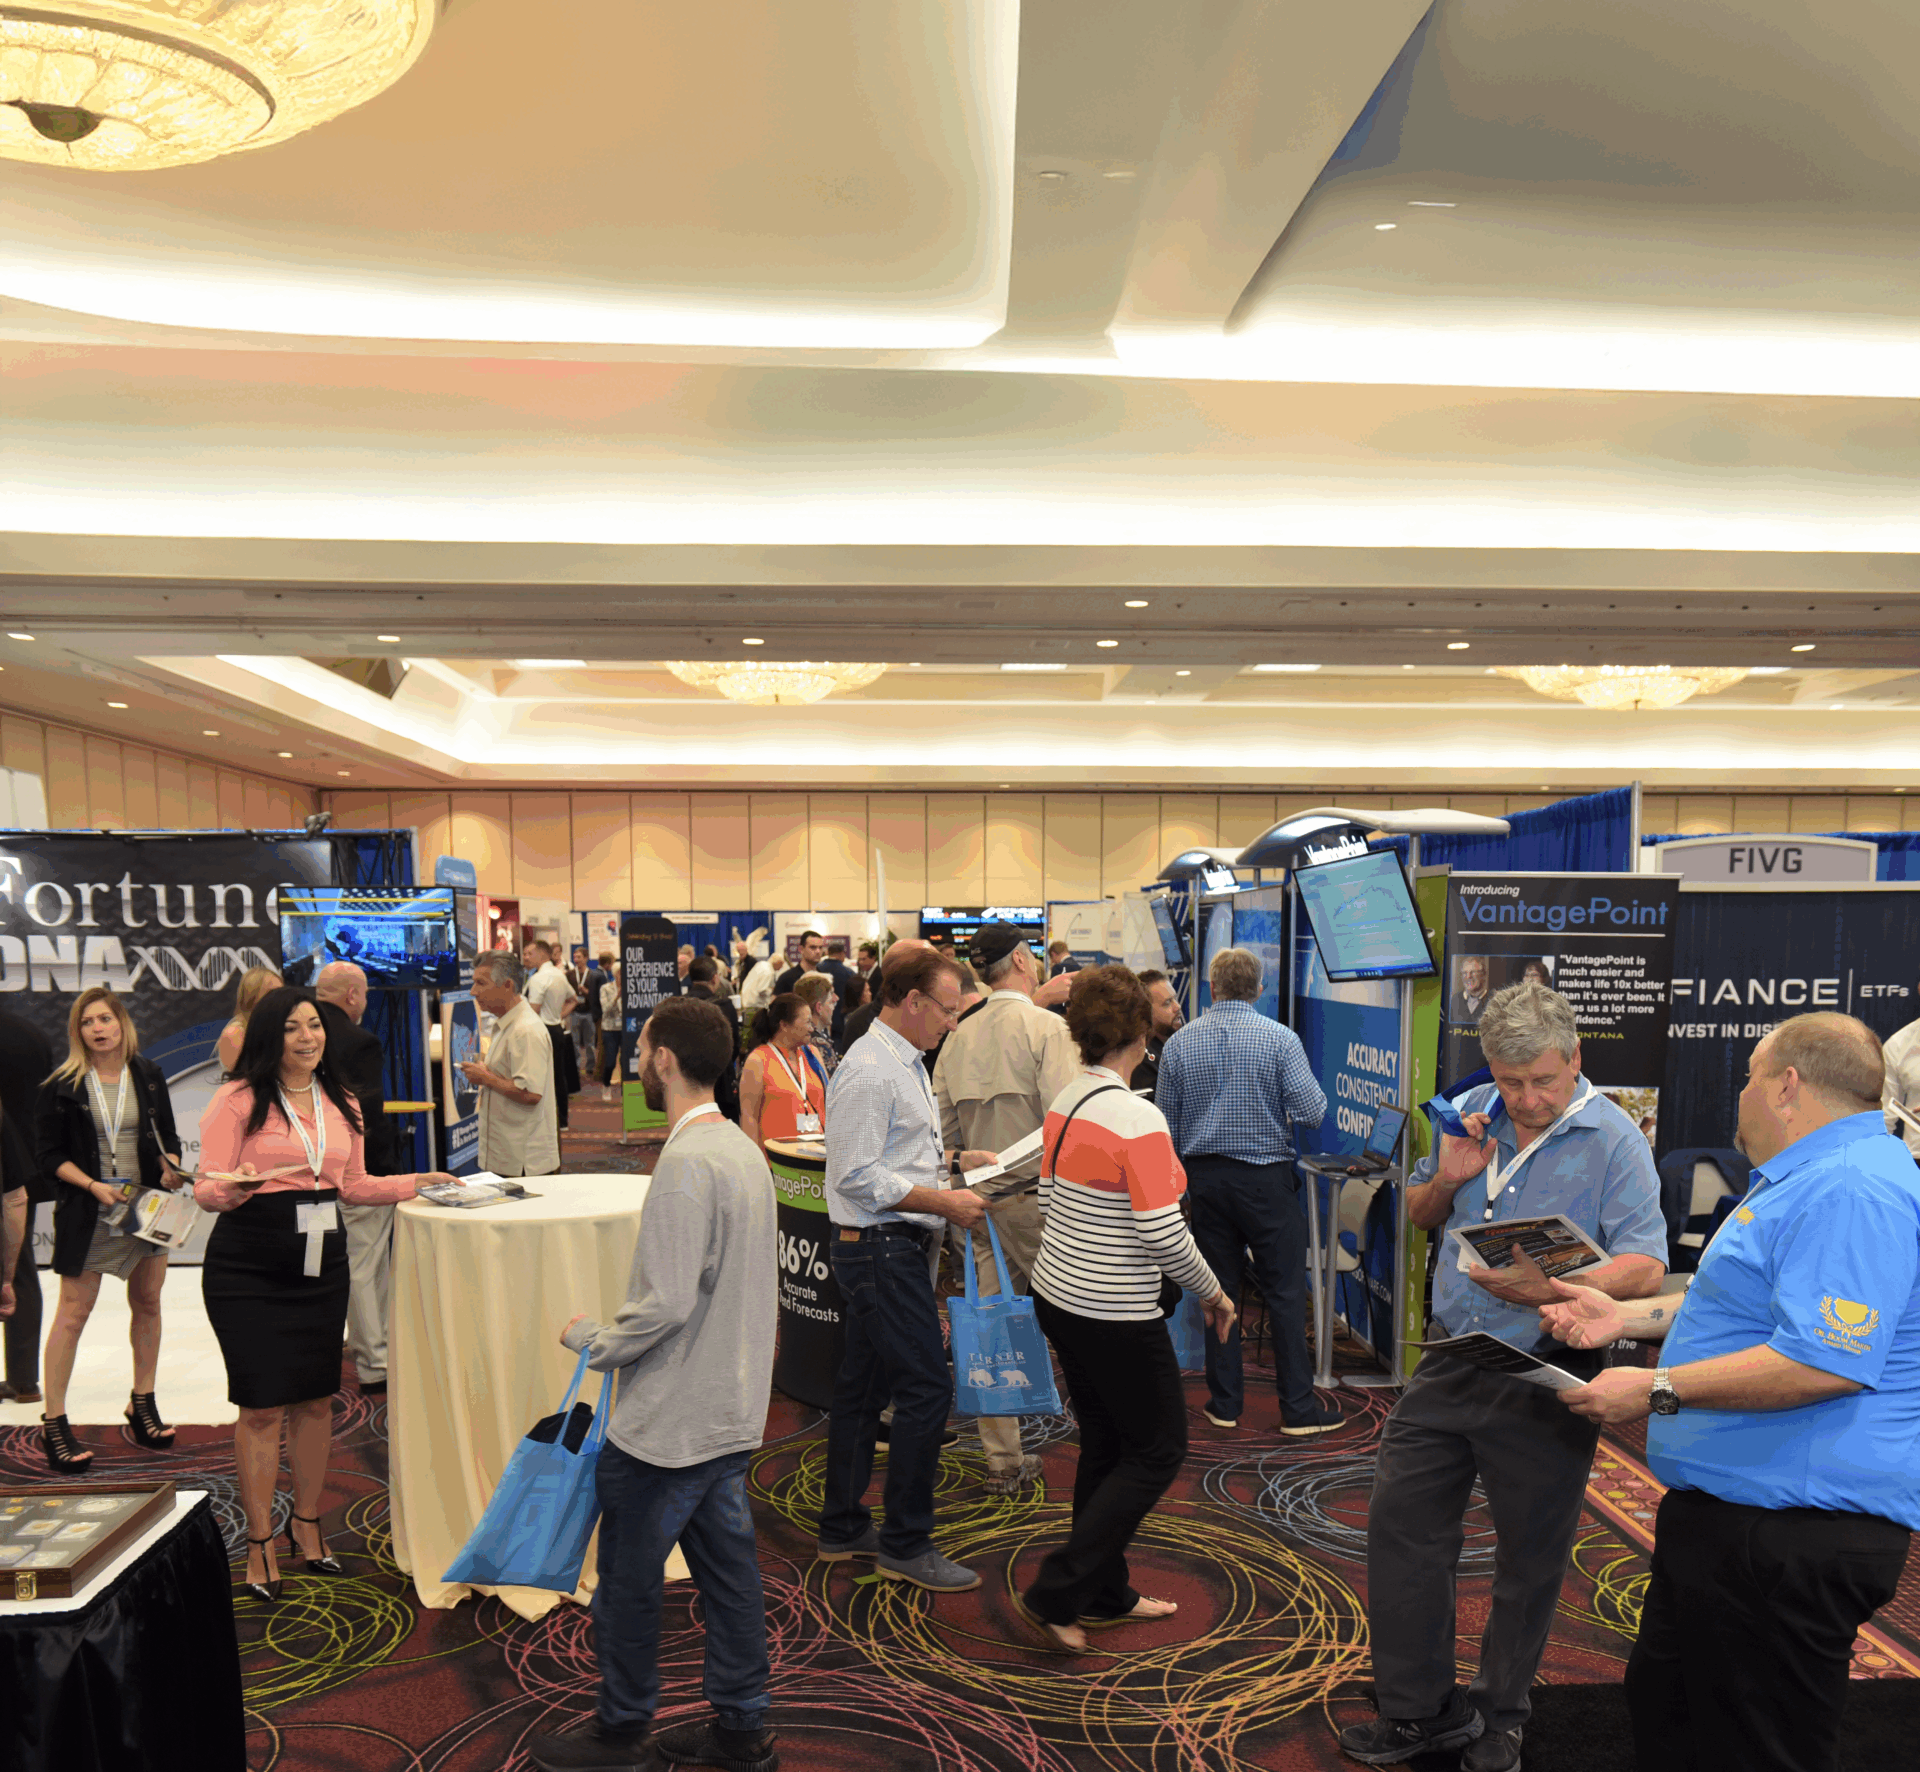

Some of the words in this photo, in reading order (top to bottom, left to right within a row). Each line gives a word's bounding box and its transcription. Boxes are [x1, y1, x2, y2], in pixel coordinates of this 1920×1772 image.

[1729, 847, 1803, 874] FIVG
[0, 856, 293, 929] Fortun
[1459, 884, 1521, 898] Introducing
[1459, 896, 1669, 932] VantagePoint
[625, 946, 644, 962] OUR
[1559, 954, 1635, 967] "VantagePoint
[1635, 955, 1647, 966] is
[626, 961, 675, 978] EXPERIENCE
[1558, 966, 1588, 977] much
[1589, 966, 1623, 978] easier
[1623, 967, 1645, 978] and
[626, 978, 636, 993] IS
[636, 977, 659, 993] YOUR
[1557, 978, 1592, 989] makes
[1593, 978, 1611, 989] life
[1612, 979, 1632, 990] 10x
[1633, 979, 1666, 990] better
[1859, 984, 1910, 998] ETFs
[1582, 990, 1599, 1001] it's
[1600, 992, 1625, 1001] ever
[1626, 991, 1656, 1002] been.
[1656, 992, 1666, 1003] It
[1586, 1004, 1600, 1013] us
[1601, 1005, 1609, 1013] a
[1610, 1003, 1626, 1014] lot
[1627, 1005, 1656, 1014] more
[1721, 1023, 1740, 1038] IN
[1346, 1041, 1399, 1079] ACCURACY
[1335, 1071, 1398, 1110] CONSISTENCY
[778, 1229, 829, 1281] 86%
[783, 1275, 818, 1302] Accurate
[792, 1298, 840, 1323] Forecasts
[1617, 1337, 1638, 1350] the
